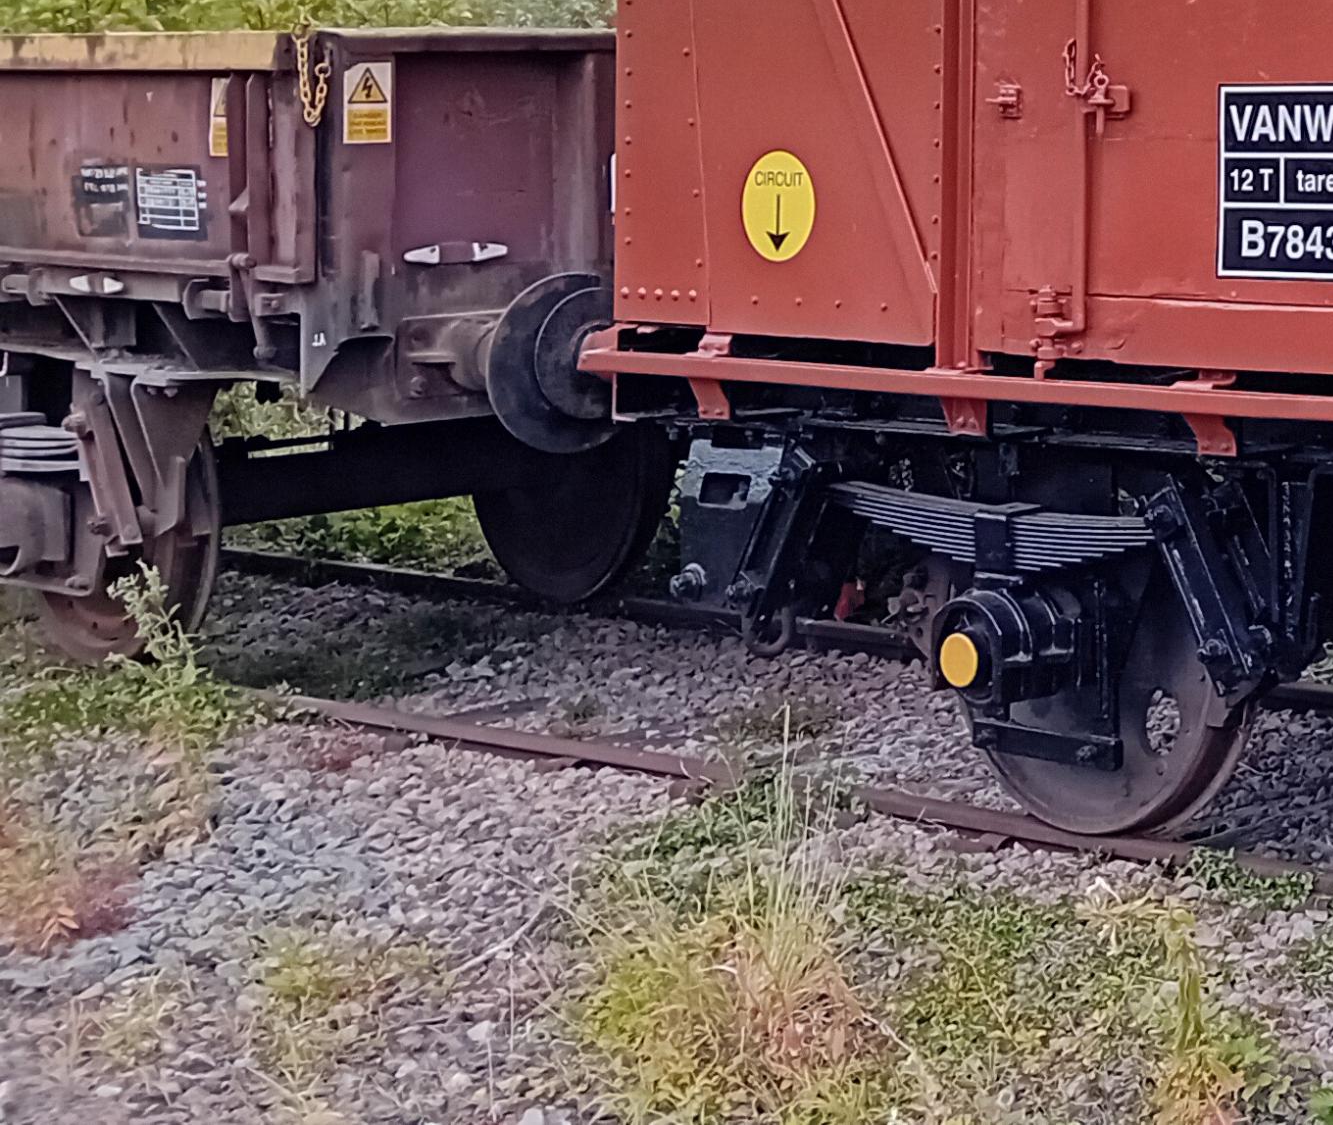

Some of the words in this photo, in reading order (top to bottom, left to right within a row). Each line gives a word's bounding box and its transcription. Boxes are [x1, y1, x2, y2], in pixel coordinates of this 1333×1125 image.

[754, 171, 804, 187] CIRCUIT
[1230, 169, 1254, 192] 12
[1259, 168, 1274, 192] T
